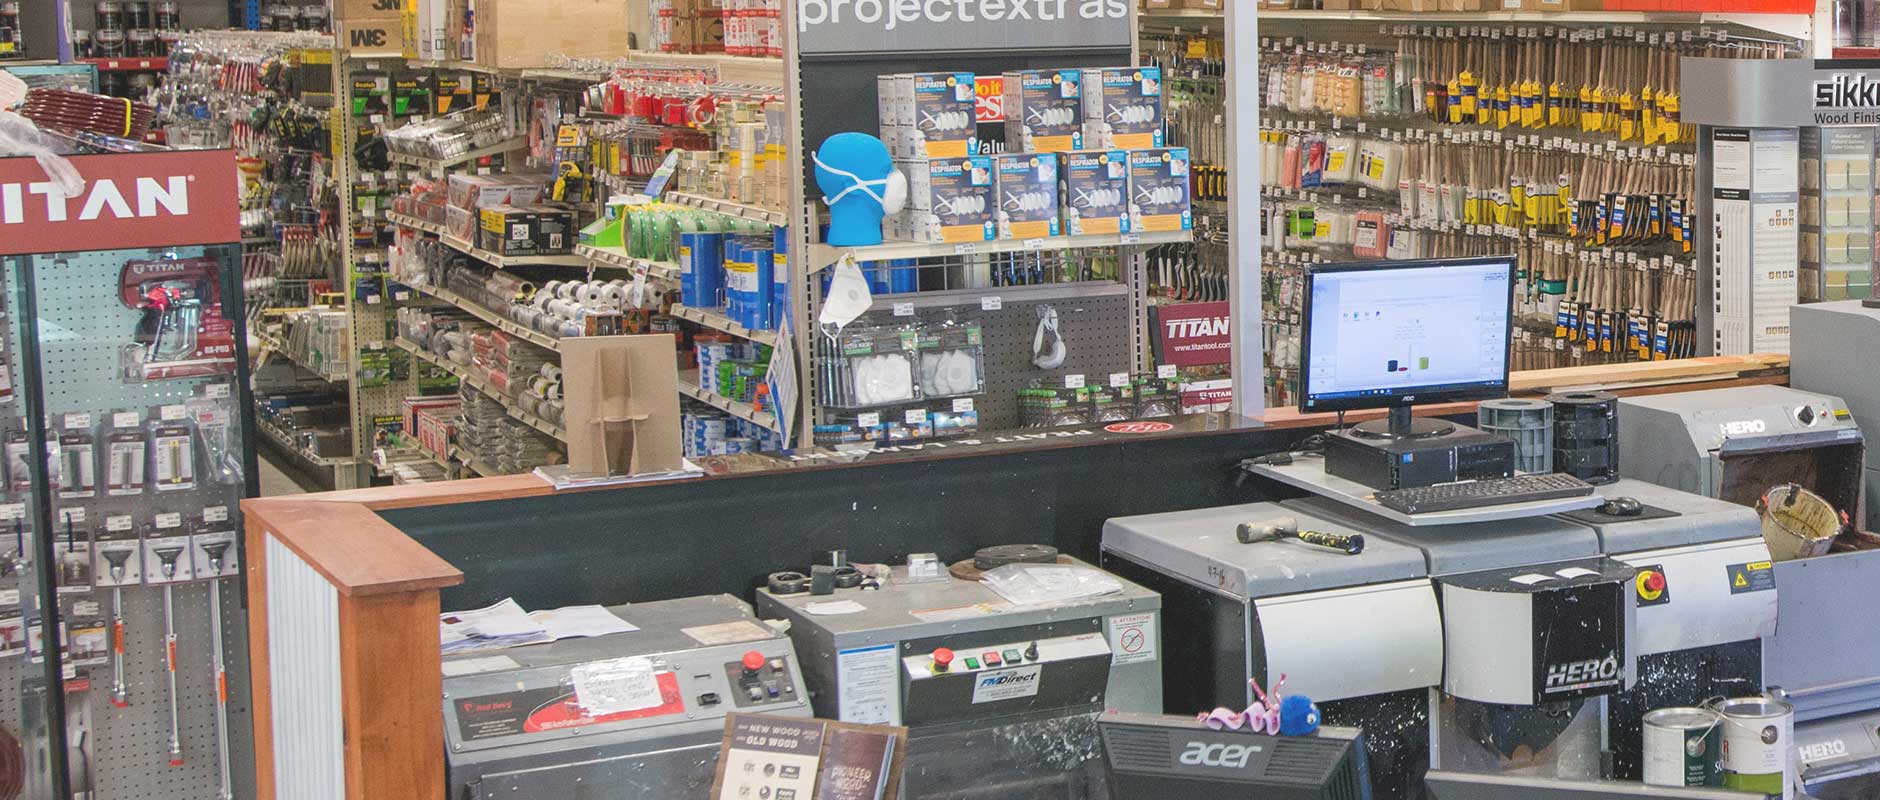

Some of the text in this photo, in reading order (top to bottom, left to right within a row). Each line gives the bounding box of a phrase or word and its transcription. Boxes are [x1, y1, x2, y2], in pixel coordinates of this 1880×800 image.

[1814, 112, 1849, 124] Wood
[2, 176, 188, 224] ITAN
[147, 263, 184, 271] TITAN
[1166, 317, 1229, 338] TITAN
[1208, 390, 1232, 398] TITAN
[1719, 419, 1766, 435] HERO
[1546, 656, 1617, 686] HERO
[749, 725, 770, 733] NEW
[772, 726, 800, 736] WOOD
[746, 736, 766, 746] OLD
[768, 738, 798, 748] WOOD
[1798, 739, 1846, 760] HERO
[1179, 741, 1262, 768] acer
[831, 767, 872, 782] PIONEER
